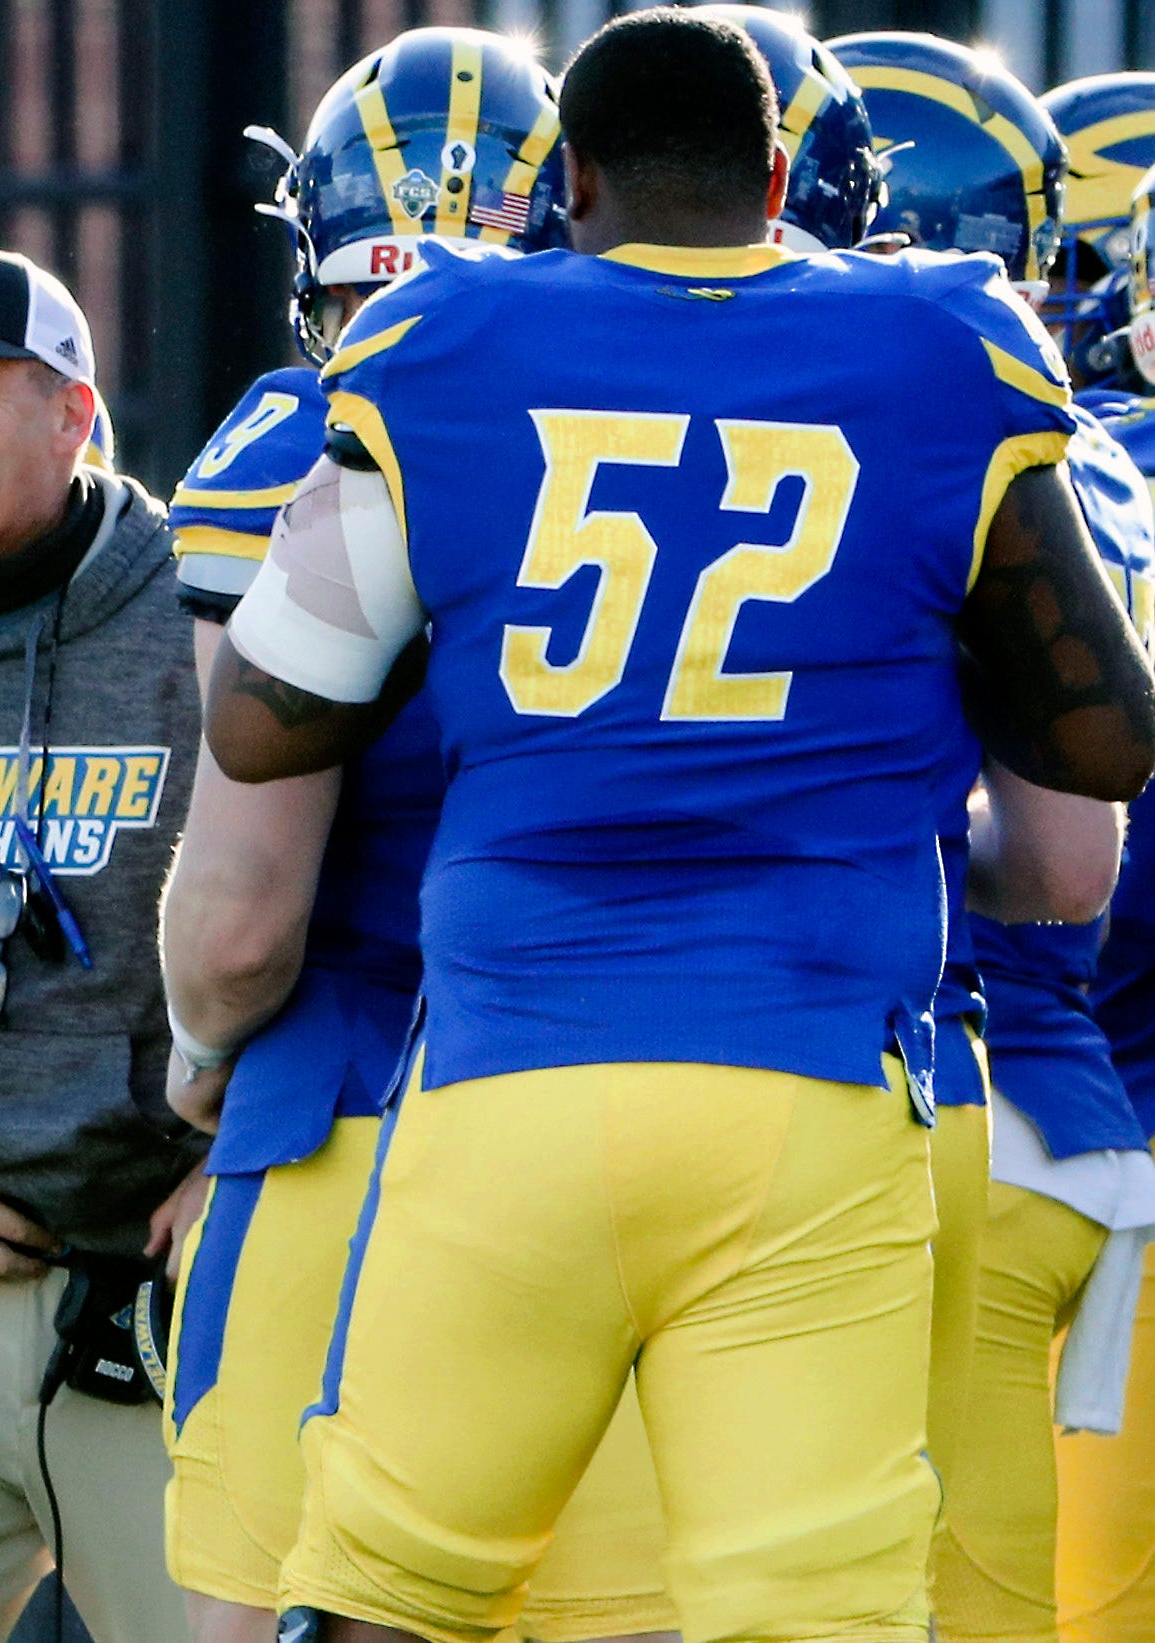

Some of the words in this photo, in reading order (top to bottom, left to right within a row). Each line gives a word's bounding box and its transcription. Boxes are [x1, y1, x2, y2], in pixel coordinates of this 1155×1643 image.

[398, 185, 432, 198] FCS
[196, 391, 300, 479] 9
[498, 408, 861, 721] 52
